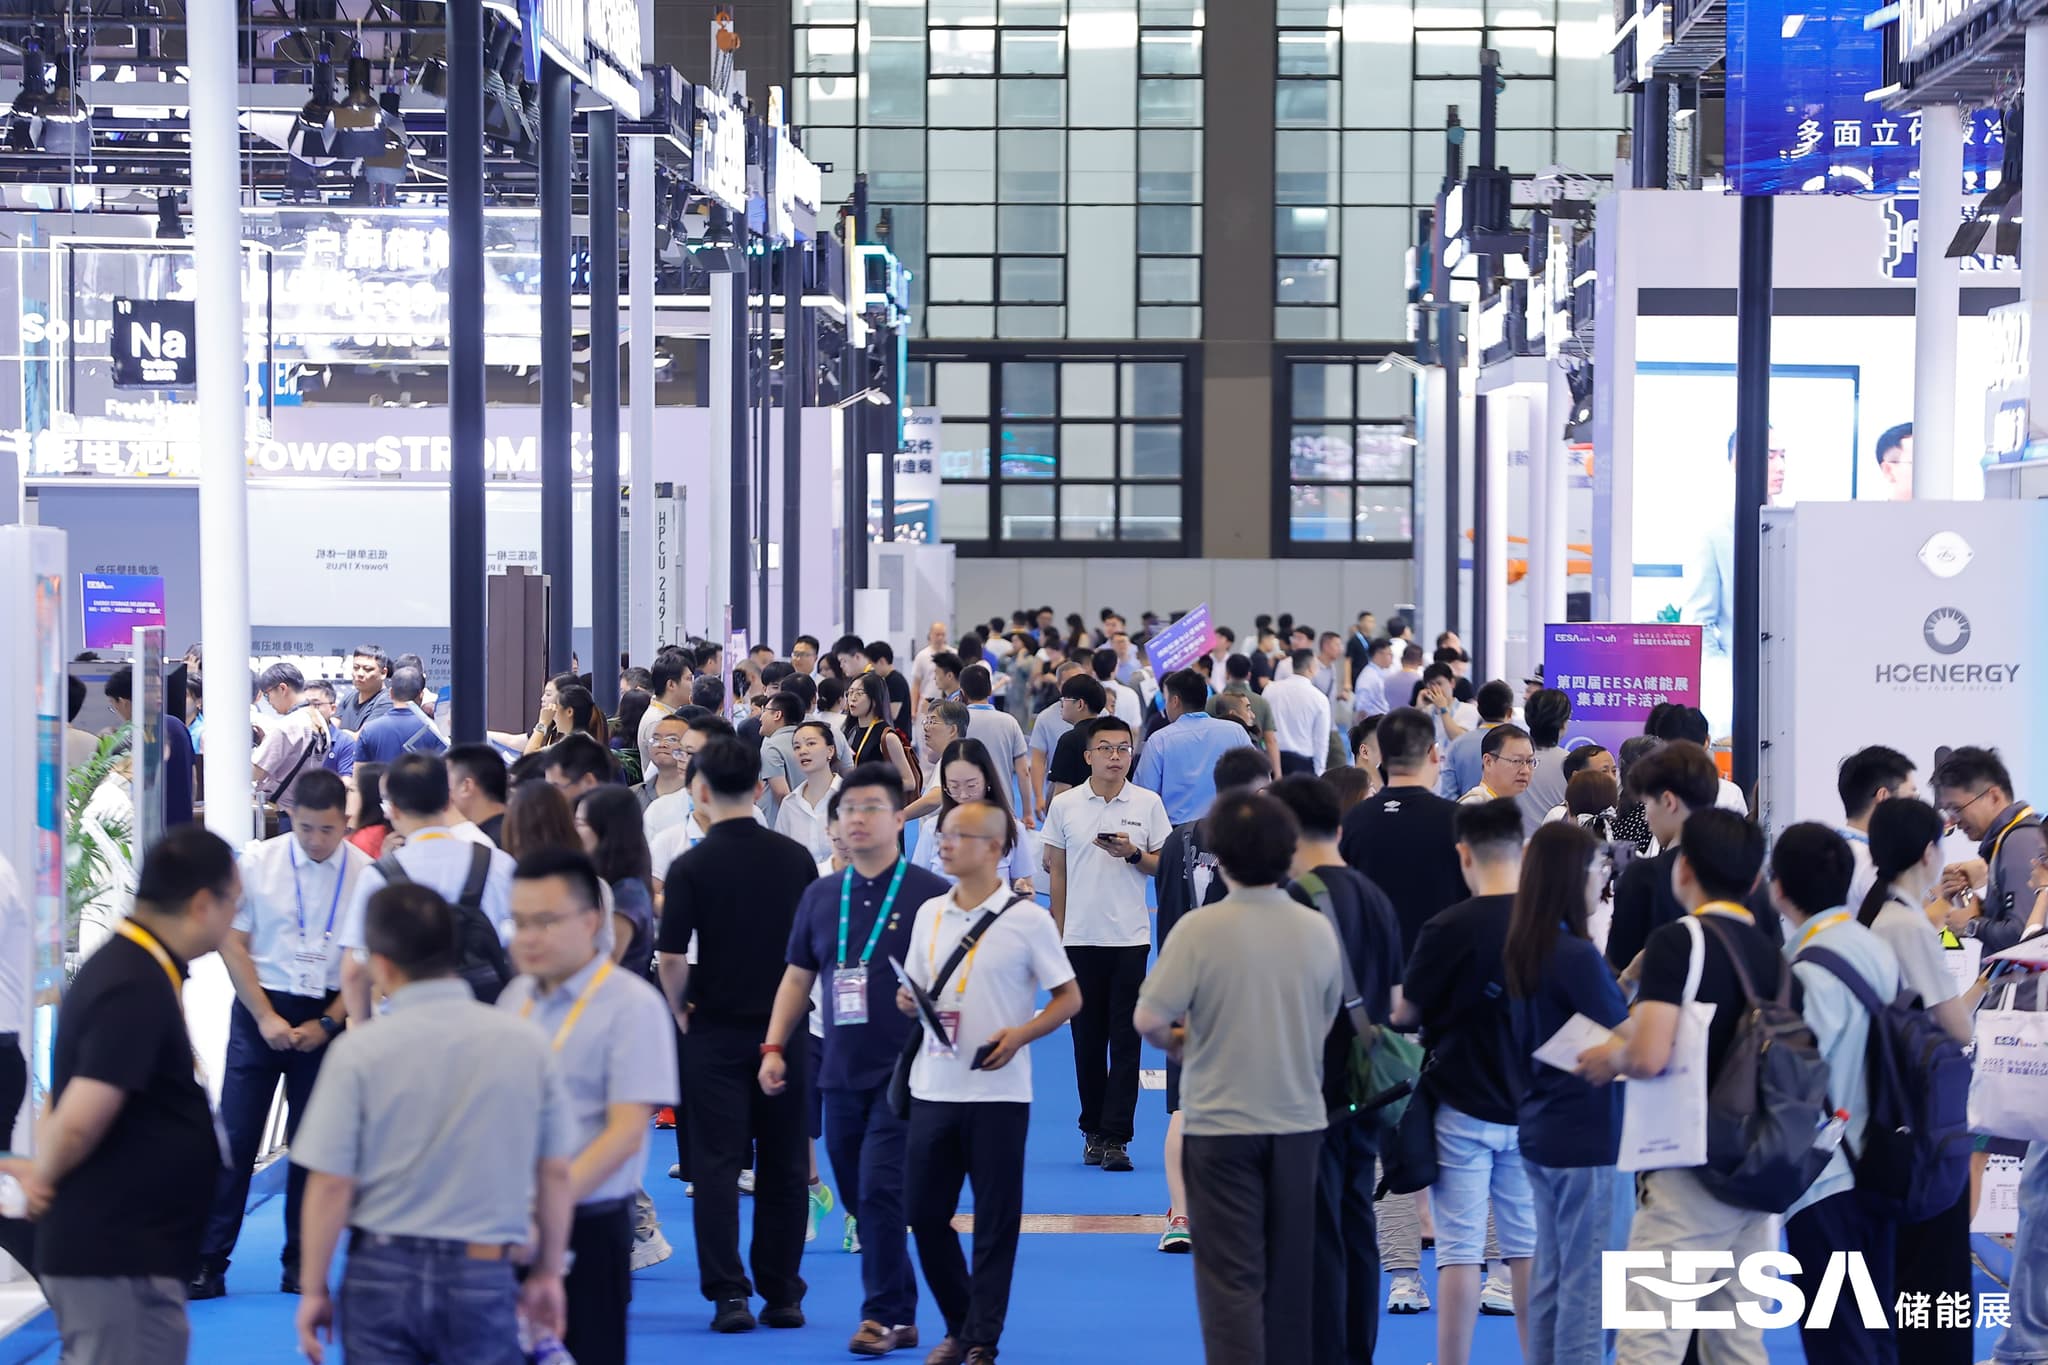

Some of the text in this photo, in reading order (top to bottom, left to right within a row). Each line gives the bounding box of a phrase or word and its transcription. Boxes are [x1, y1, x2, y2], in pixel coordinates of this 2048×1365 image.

[23, 313, 114, 344] Sour
[131, 322, 187, 359] Na
[658, 511, 667, 649] HPCU 24915
[431, 657, 450, 665] Pow
[1556, 674, 1689, 692] 第四届EESA储能展
[1875, 664, 2021, 683] HOENERGY
[1576, 692, 1668, 708] 集章打卡活动
